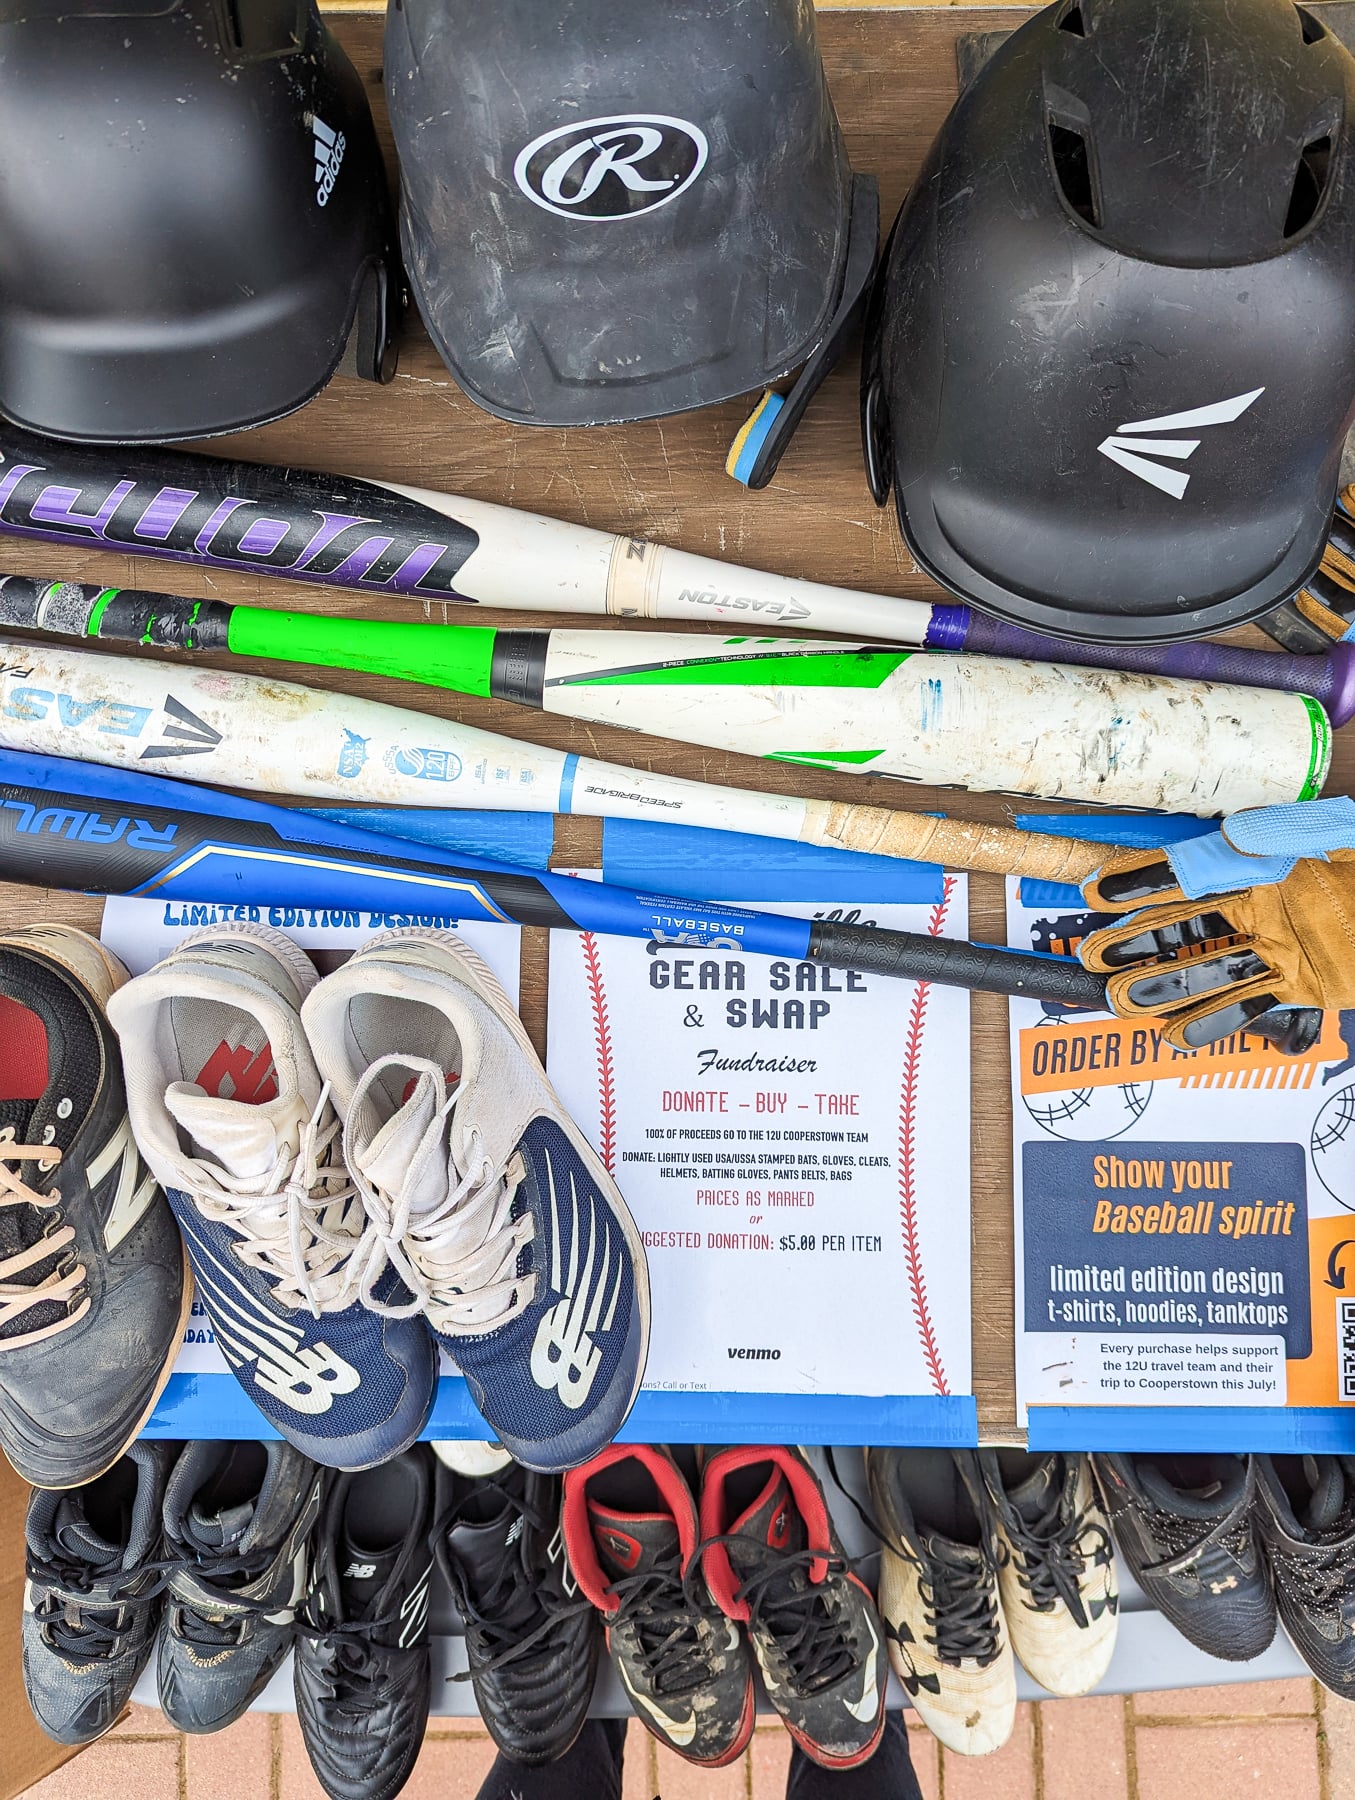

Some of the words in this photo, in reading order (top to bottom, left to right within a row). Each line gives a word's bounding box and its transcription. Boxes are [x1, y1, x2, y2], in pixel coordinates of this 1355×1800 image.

[317, 131, 346, 207] adidas
[679, 588, 786, 615] EASTON
[342, 748, 355, 776] NSA
[353, 742, 364, 767] 2012
[425, 751, 446, 779] 1.20
[0, 798, 179, 852] RAWL
[652, 915, 745, 936] BASEBALL
[649, 960, 746, 991] GEAR
[769, 961, 868, 993] SALE
[683, 1004, 705, 1028] &
[726, 998, 831, 1030] SWAP
[697, 1048, 818, 1075] Fundraiser
[1032, 1032, 1120, 1076] ORDER
[1130, 1029, 1164, 1065] BY
[662, 1091, 729, 1112] DONATE
[756, 1092, 788, 1114] BUY
[814, 1093, 860, 1116] TAKE
[645, 1128, 664, 1139] 100%
[666, 1129, 677, 1139] OF
[680, 1129, 721, 1140] PROCEEDS
[723, 1130, 735, 1140] GO
[737, 1130, 747, 1140] TO
[749, 1130, 764, 1141] THE
[766, 1130, 781, 1141] 12U
[783, 1131, 844, 1142] COOPERSTOWN
[846, 1132, 869, 1143] TEAM
[622, 1151, 656, 1162] DONATE:
[658, 1152, 690, 1163] LIGHTLY
[692, 1153, 713, 1163] USED
[715, 1153, 756, 1164] USA/USSA
[758, 1154, 796, 1165] STAMPED
[798, 1154, 820, 1166] BATS,
[822, 1155, 857, 1167] GLOVES,
[859, 1156, 891, 1168] CLEATS,
[660, 1168, 700, 1179] HELMETS,
[702, 1168, 735, 1179] BATTING
[737, 1169, 771, 1180] GLOVES,
[774, 1169, 799, 1180] PANTS
[801, 1170, 828, 1181] BELTS,
[830, 1171, 852, 1181] BAGS
[1093, 1155, 1165, 1188] Show
[1171, 1160, 1233, 1193] your
[697, 1190, 739, 1206] PRICES
[746, 1190, 761, 1206] AS
[768, 1191, 815, 1207] MARKED
[749, 1215, 763, 1224] or
[1092, 1200, 1214, 1234] Baseball
[1218, 1200, 1296, 1239] spirit
[641, 1231, 701, 1248] GGESTED
[708, 1233, 774, 1250] DONATION:
[779, 1235, 816, 1252] $5.00
[822, 1235, 845, 1252] PER
[852, 1235, 882, 1252] ITEM
[1050, 1265, 1126, 1293] limited
[1131, 1266, 1207, 1294] edition
[1211, 1267, 1284, 1297] design
[1048, 1299, 1122, 1326] t-shirts,
[1126, 1300, 1203, 1327] hoodies,
[1206, 1301, 1288, 1328] tanktops
[183, 1329, 215, 1343] DAY
[727, 1346, 781, 1361] venmo
[1100, 1343, 1134, 1355] Every
[1137, 1344, 1192, 1355] purchase
[1195, 1344, 1228, 1356] helps
[1232, 1345, 1279, 1357] support
[1103, 1361, 1122, 1371] the
[1125, 1361, 1148, 1371] 12U
[1151, 1361, 1184, 1371] travel
[1187, 1363, 1216, 1372] team
[1220, 1362, 1242, 1372] and
[1245, 1363, 1273, 1373] their
[642, 1381, 660, 1389] ons?
[662, 1381, 677, 1389] Call
[1100, 1378, 1120, 1390] trip
[1124, 1380, 1135, 1389] to
[1139, 1379, 1219, 1391] Cooperstown
[1222, 1380, 1244, 1389] this
[1247, 1380, 1276, 1392] July!
